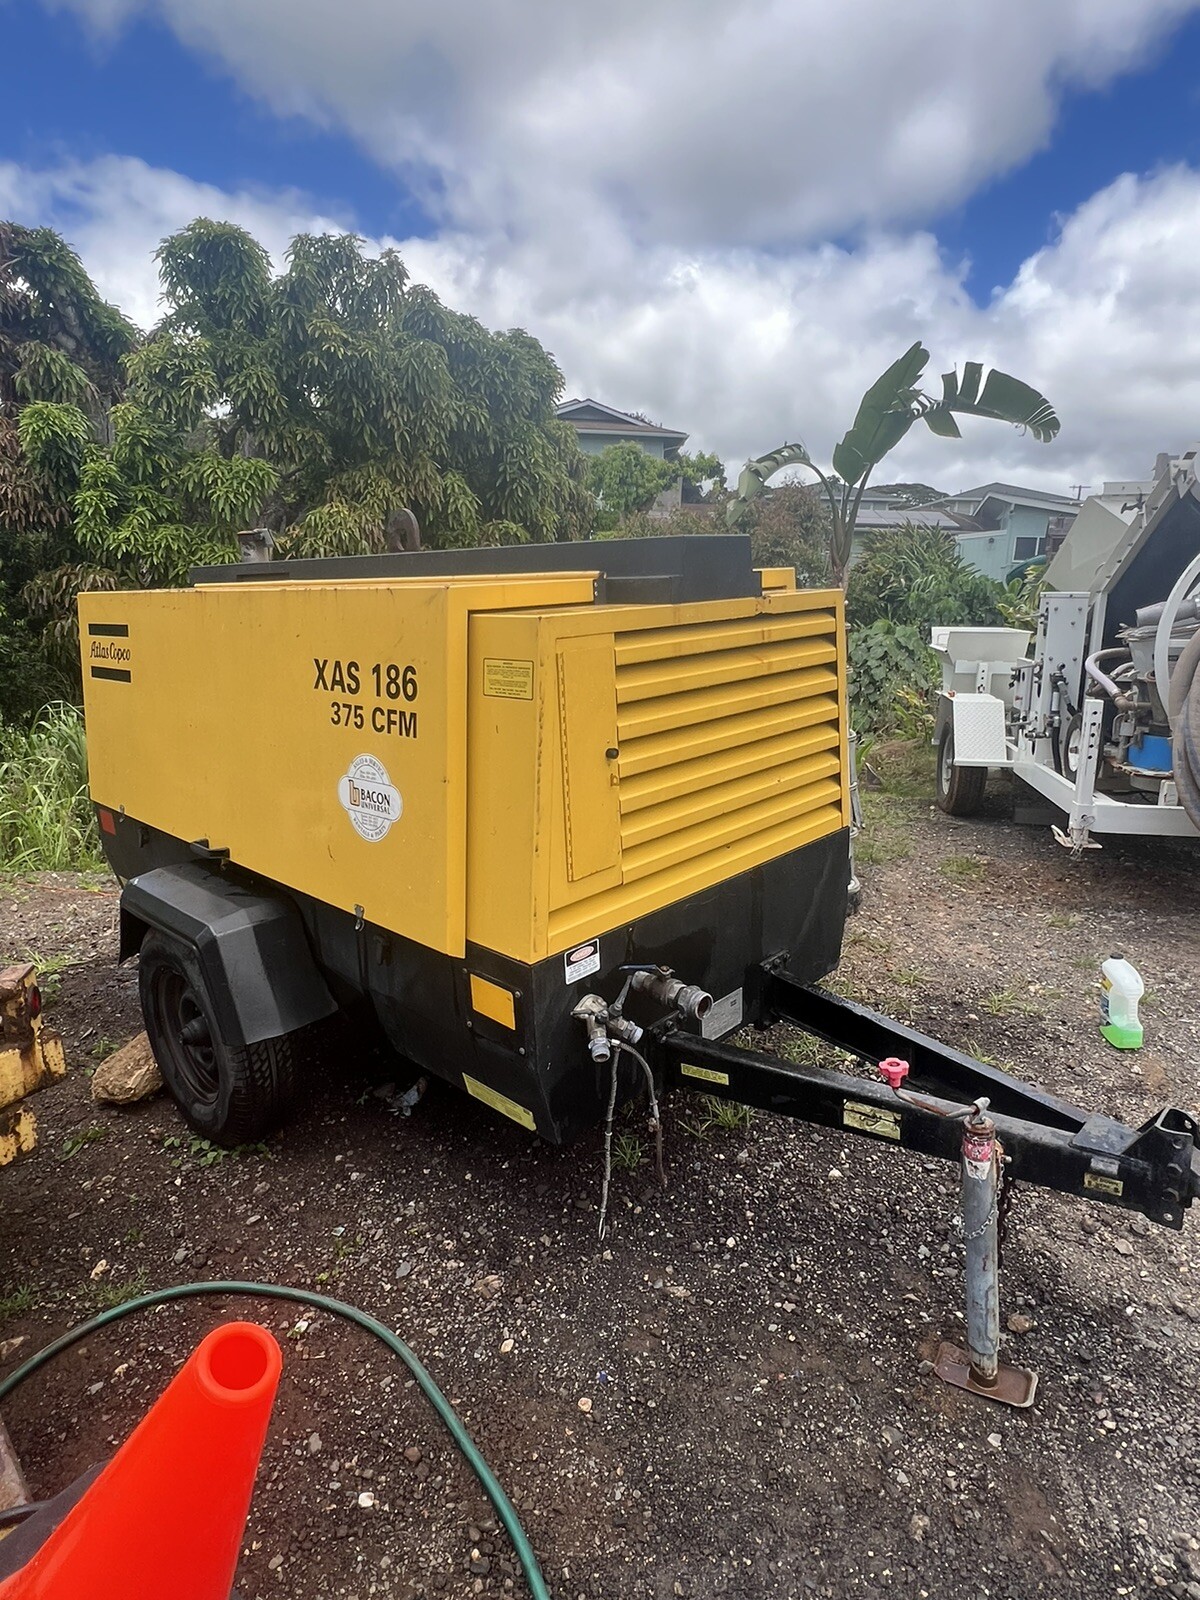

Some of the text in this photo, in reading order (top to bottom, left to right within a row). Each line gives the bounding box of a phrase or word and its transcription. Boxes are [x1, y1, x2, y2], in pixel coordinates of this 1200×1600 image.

[90, 641, 131, 664] Atlas Copco
[314, 658, 418, 702] XAS 186
[331, 701, 417, 739] 375 CFM
[361, 788, 391, 807] BACON
[361, 801, 391, 815] UNIVERSAL
